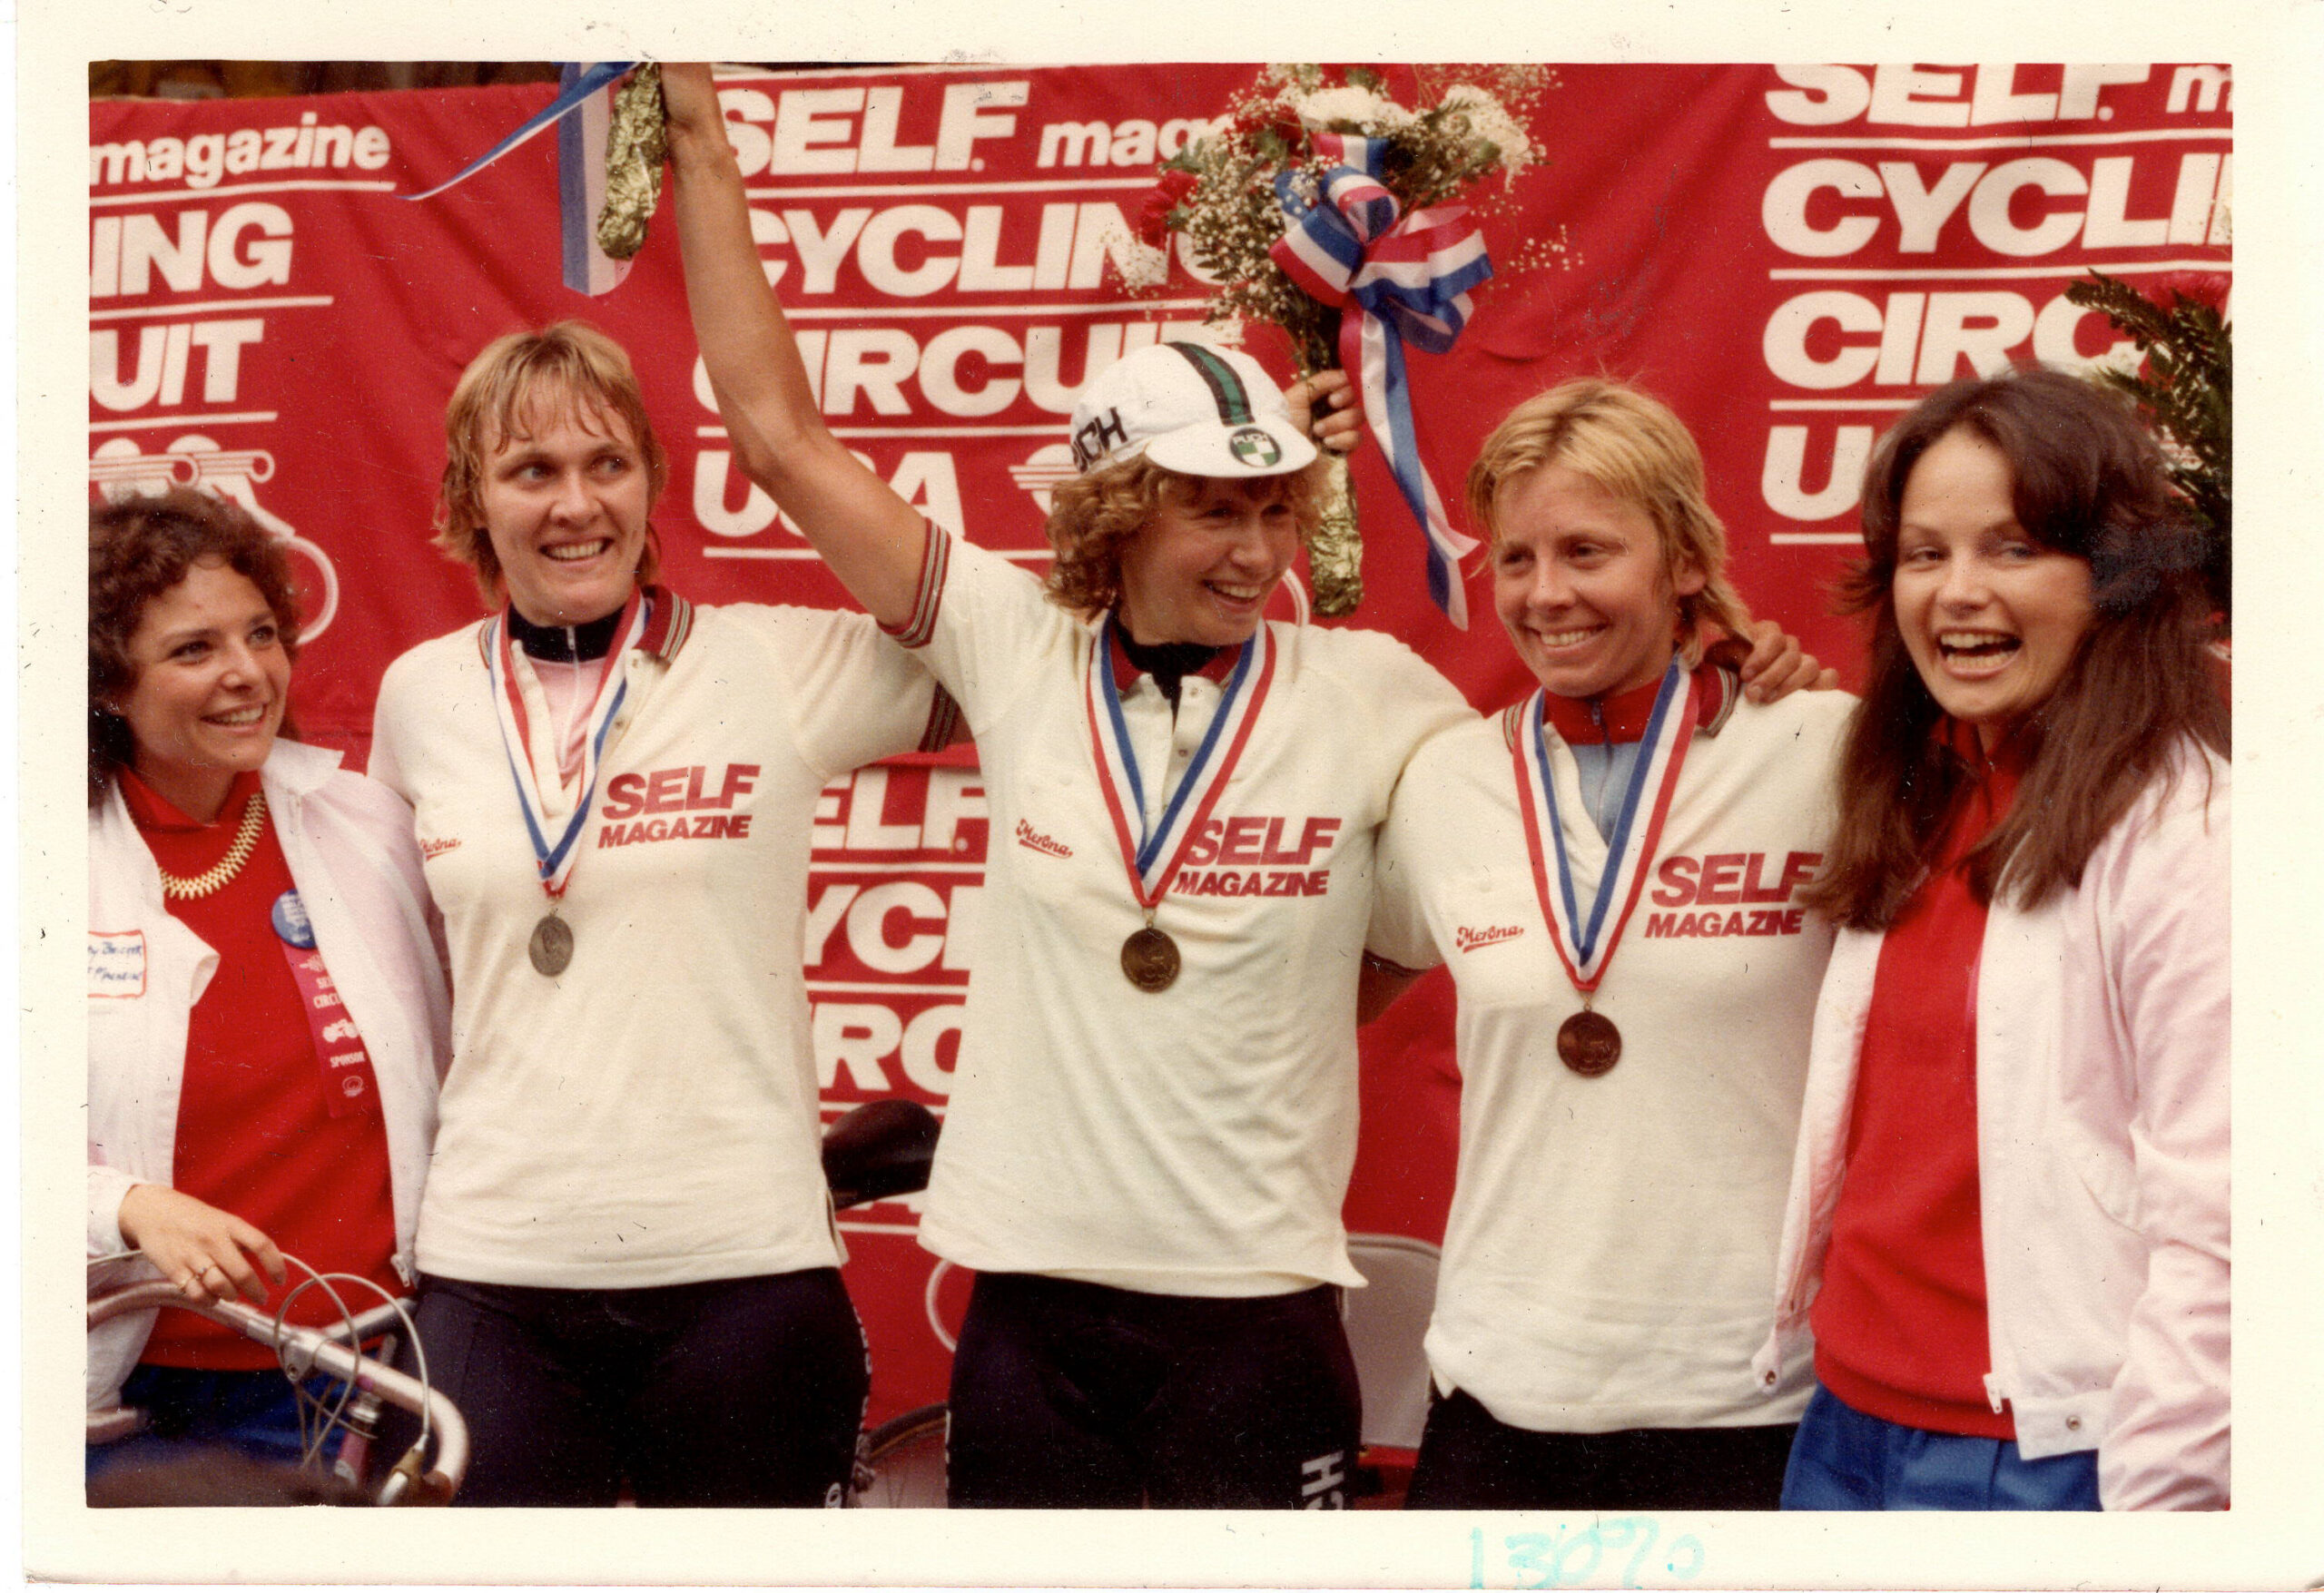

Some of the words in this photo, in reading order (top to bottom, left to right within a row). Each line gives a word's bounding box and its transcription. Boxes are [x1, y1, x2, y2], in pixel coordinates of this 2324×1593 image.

[89, 113, 390, 190] magazine
[1762, 153, 2232, 258] CYCLI
[693, 451, 965, 538] UA
[601, 763, 761, 821] SELF
[597, 814, 753, 849] MAGAZINE
[1183, 816, 1342, 866] SELF
[1172, 870, 1330, 898] MAGAZINE
[1651, 851, 1824, 908] SELF
